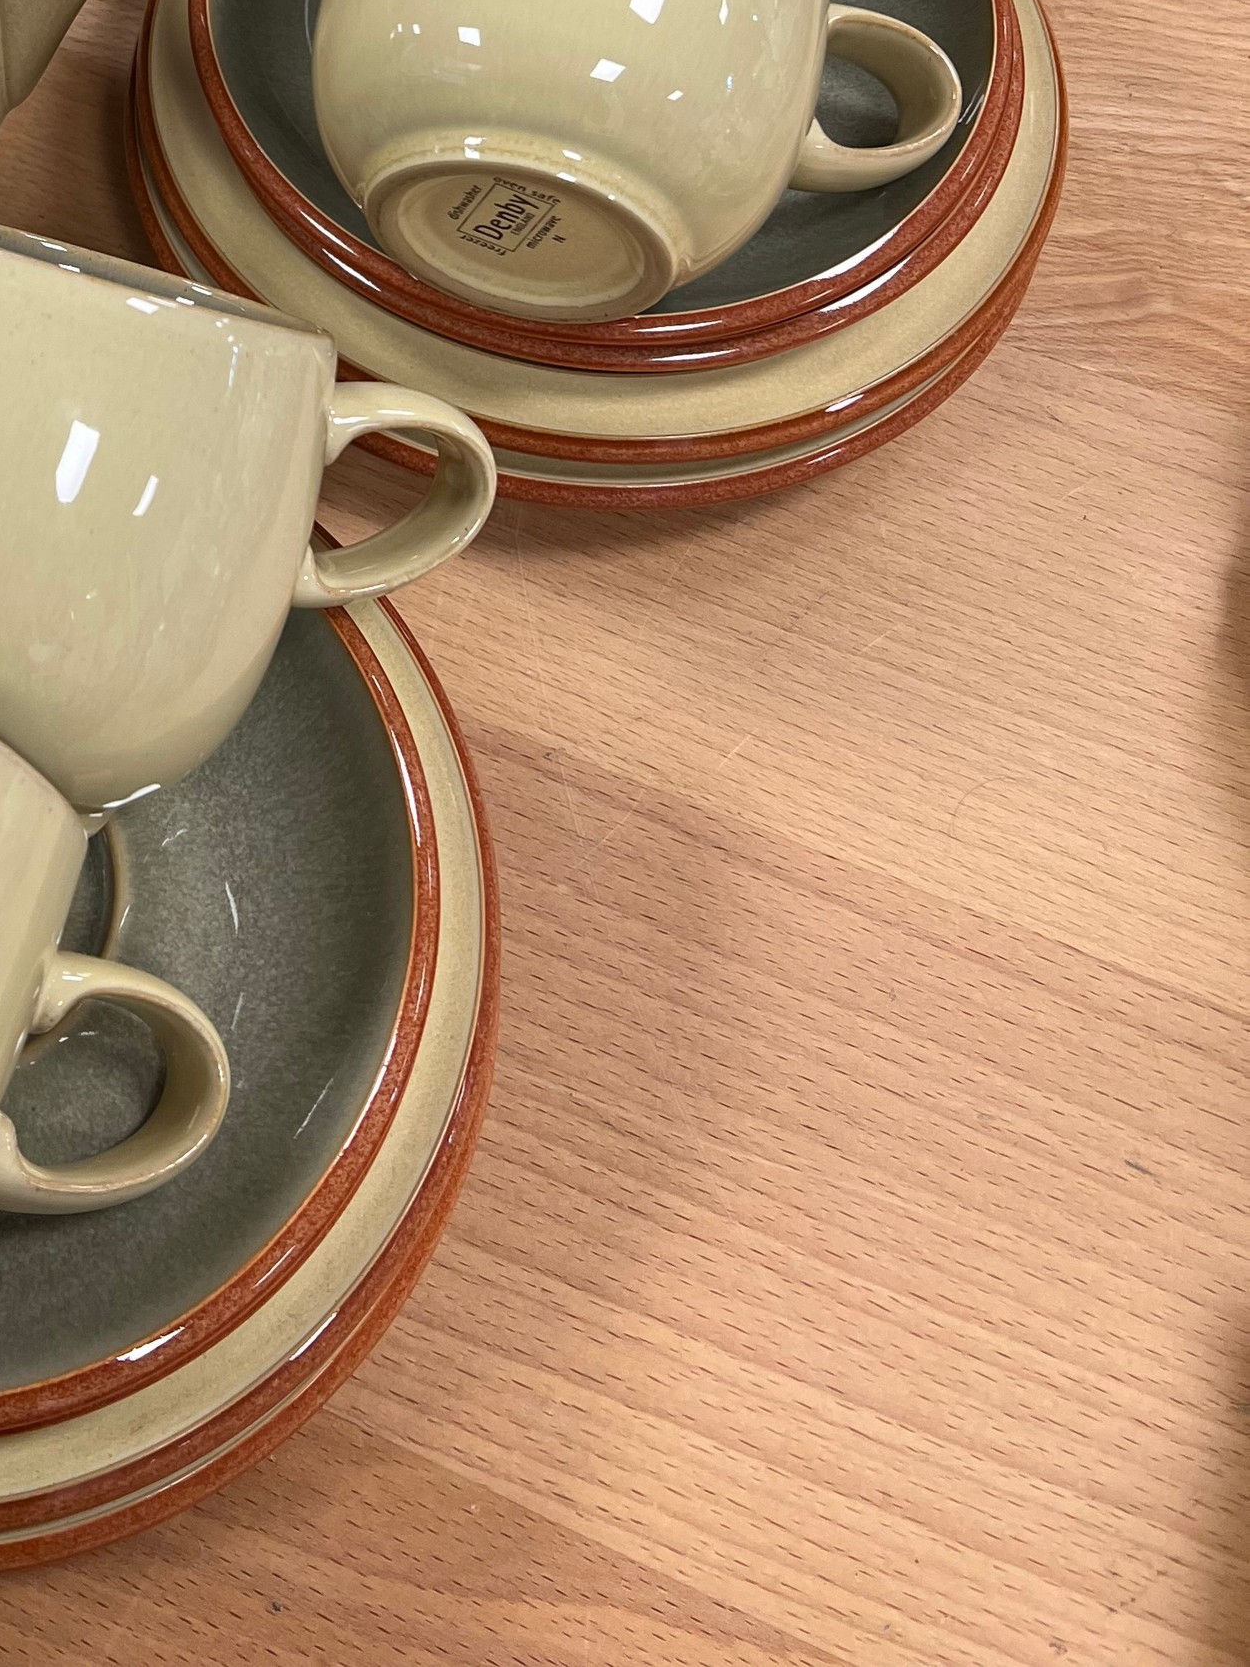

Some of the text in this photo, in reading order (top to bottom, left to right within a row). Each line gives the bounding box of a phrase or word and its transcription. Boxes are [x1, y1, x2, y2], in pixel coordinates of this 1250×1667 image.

[447, 184, 482, 220] dishwasher
[492, 176, 562, 207] oven safe
[471, 193, 540, 241] Denby
[525, 214, 563, 250] microwave
[459, 234, 507, 256] freezer
